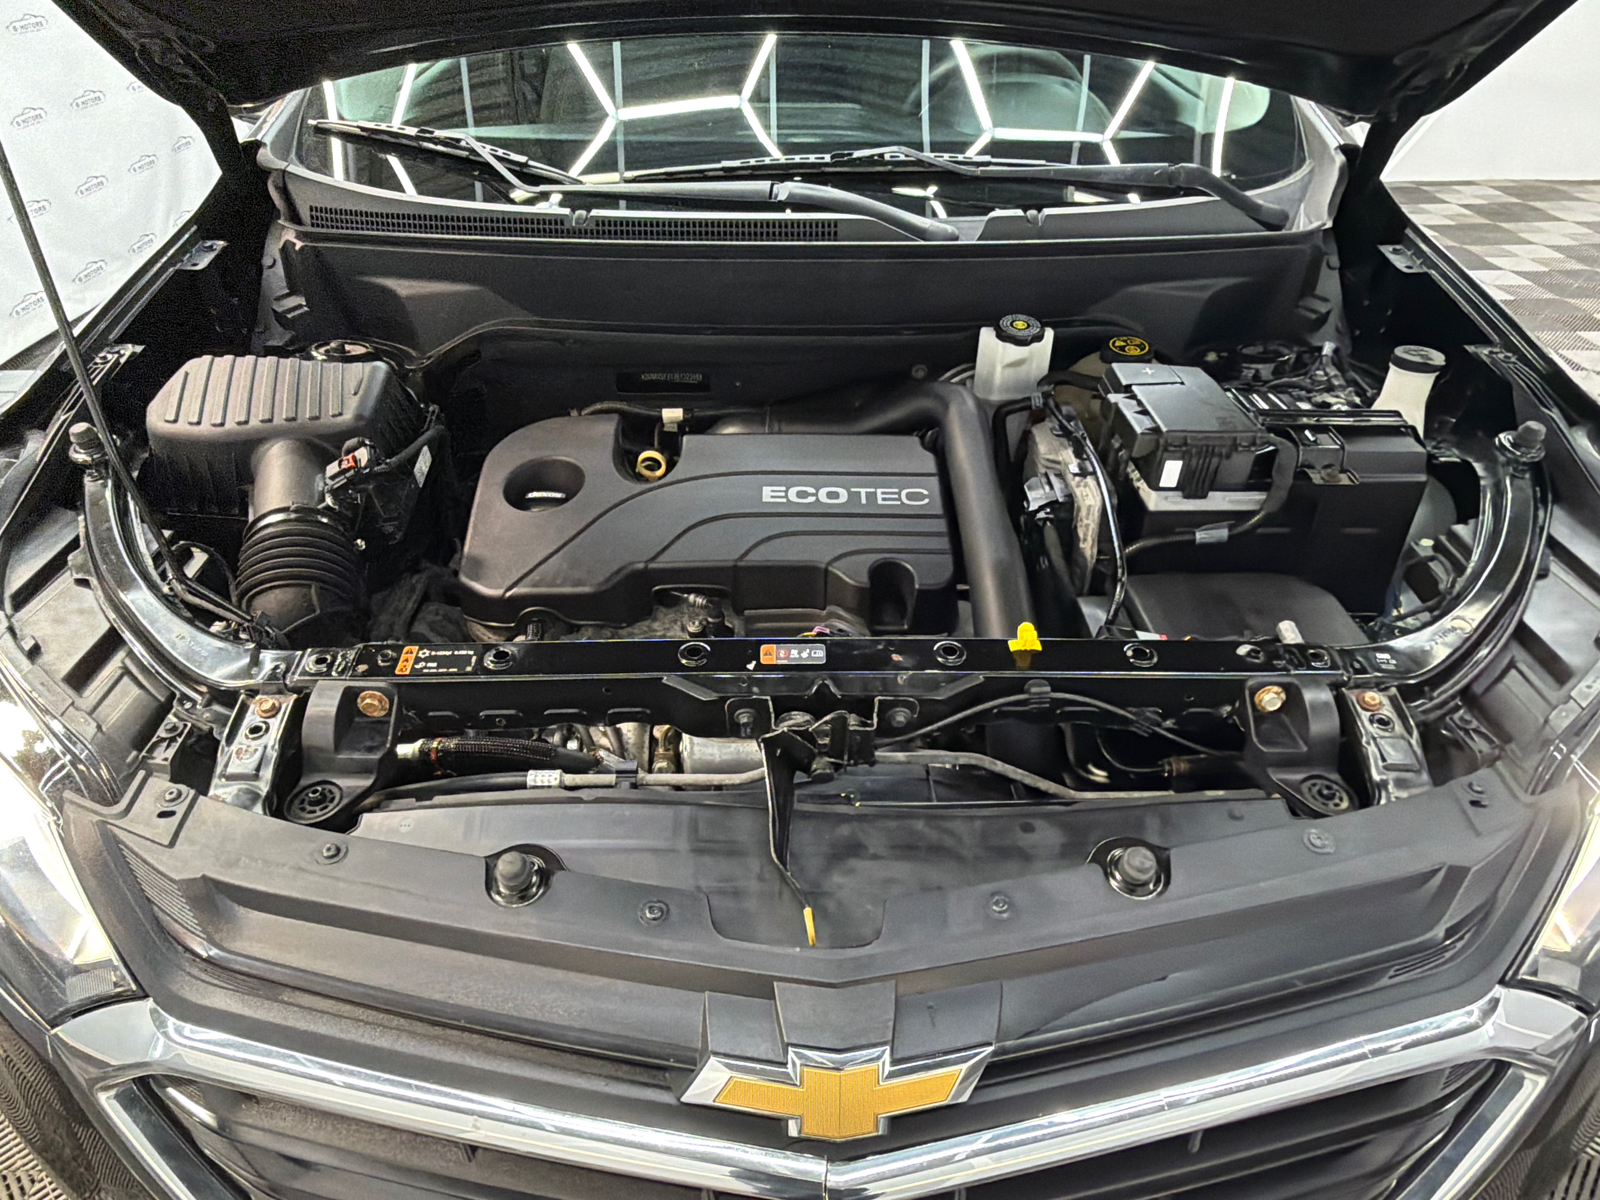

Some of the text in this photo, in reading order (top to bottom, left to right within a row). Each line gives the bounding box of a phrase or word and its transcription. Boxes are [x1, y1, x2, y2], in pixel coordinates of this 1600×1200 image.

[20, 20, 44, 31] MOTORS
[81, 95, 102, 106] MOTORS
[21, 296, 45, 312] MOTORS
[762, 486, 930, 505] ECOTEC
